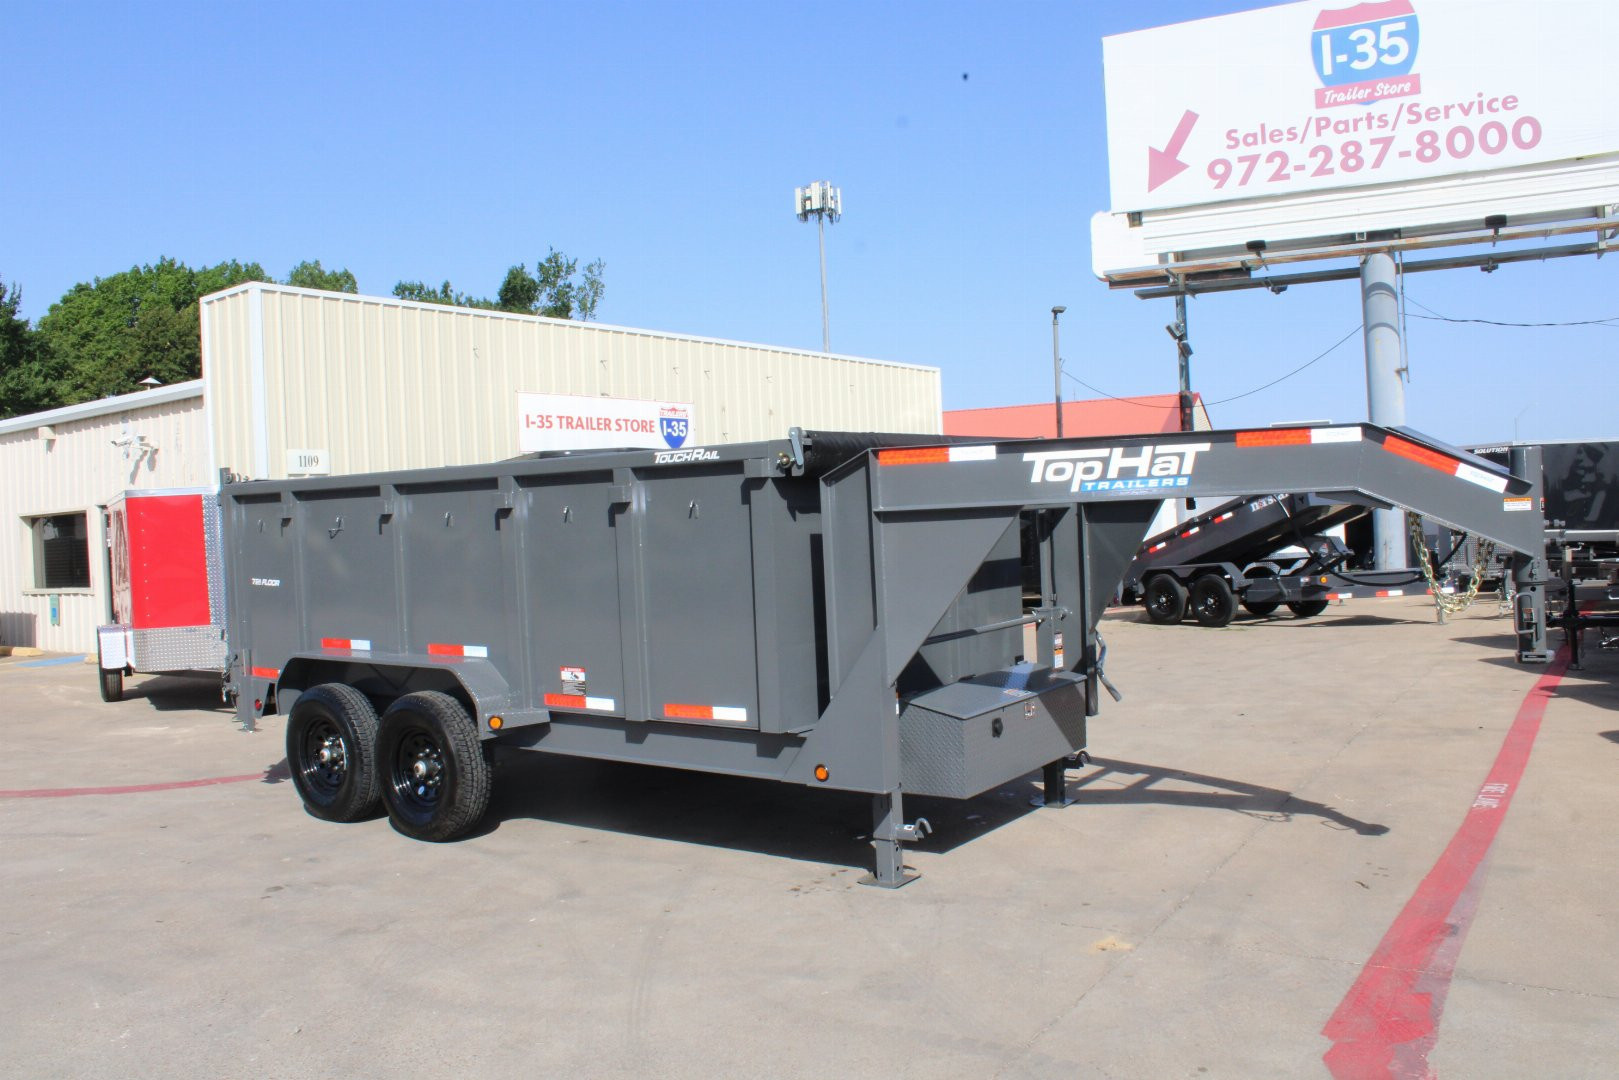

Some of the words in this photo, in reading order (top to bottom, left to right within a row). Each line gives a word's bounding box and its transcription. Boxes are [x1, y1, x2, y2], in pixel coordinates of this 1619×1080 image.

[1321, 21, 1409, 76] I-35
[1324, 86, 1372, 104] Trailer
[1374, 81, 1412, 97] Store
[1225, 92, 1519, 150] Sales/Parts/Service
[1207, 115, 1542, 189] 972-287-8000
[525, 414, 553, 429] I-35
[557, 415, 611, 431] TRAILER
[615, 418, 656, 433] STORE
[663, 420, 687, 437] I-35
[1473, 446, 1509, 455] SOLUTION
[298, 455, 319, 467] 1109
[1084, 477, 1189, 491] TRAILERS
